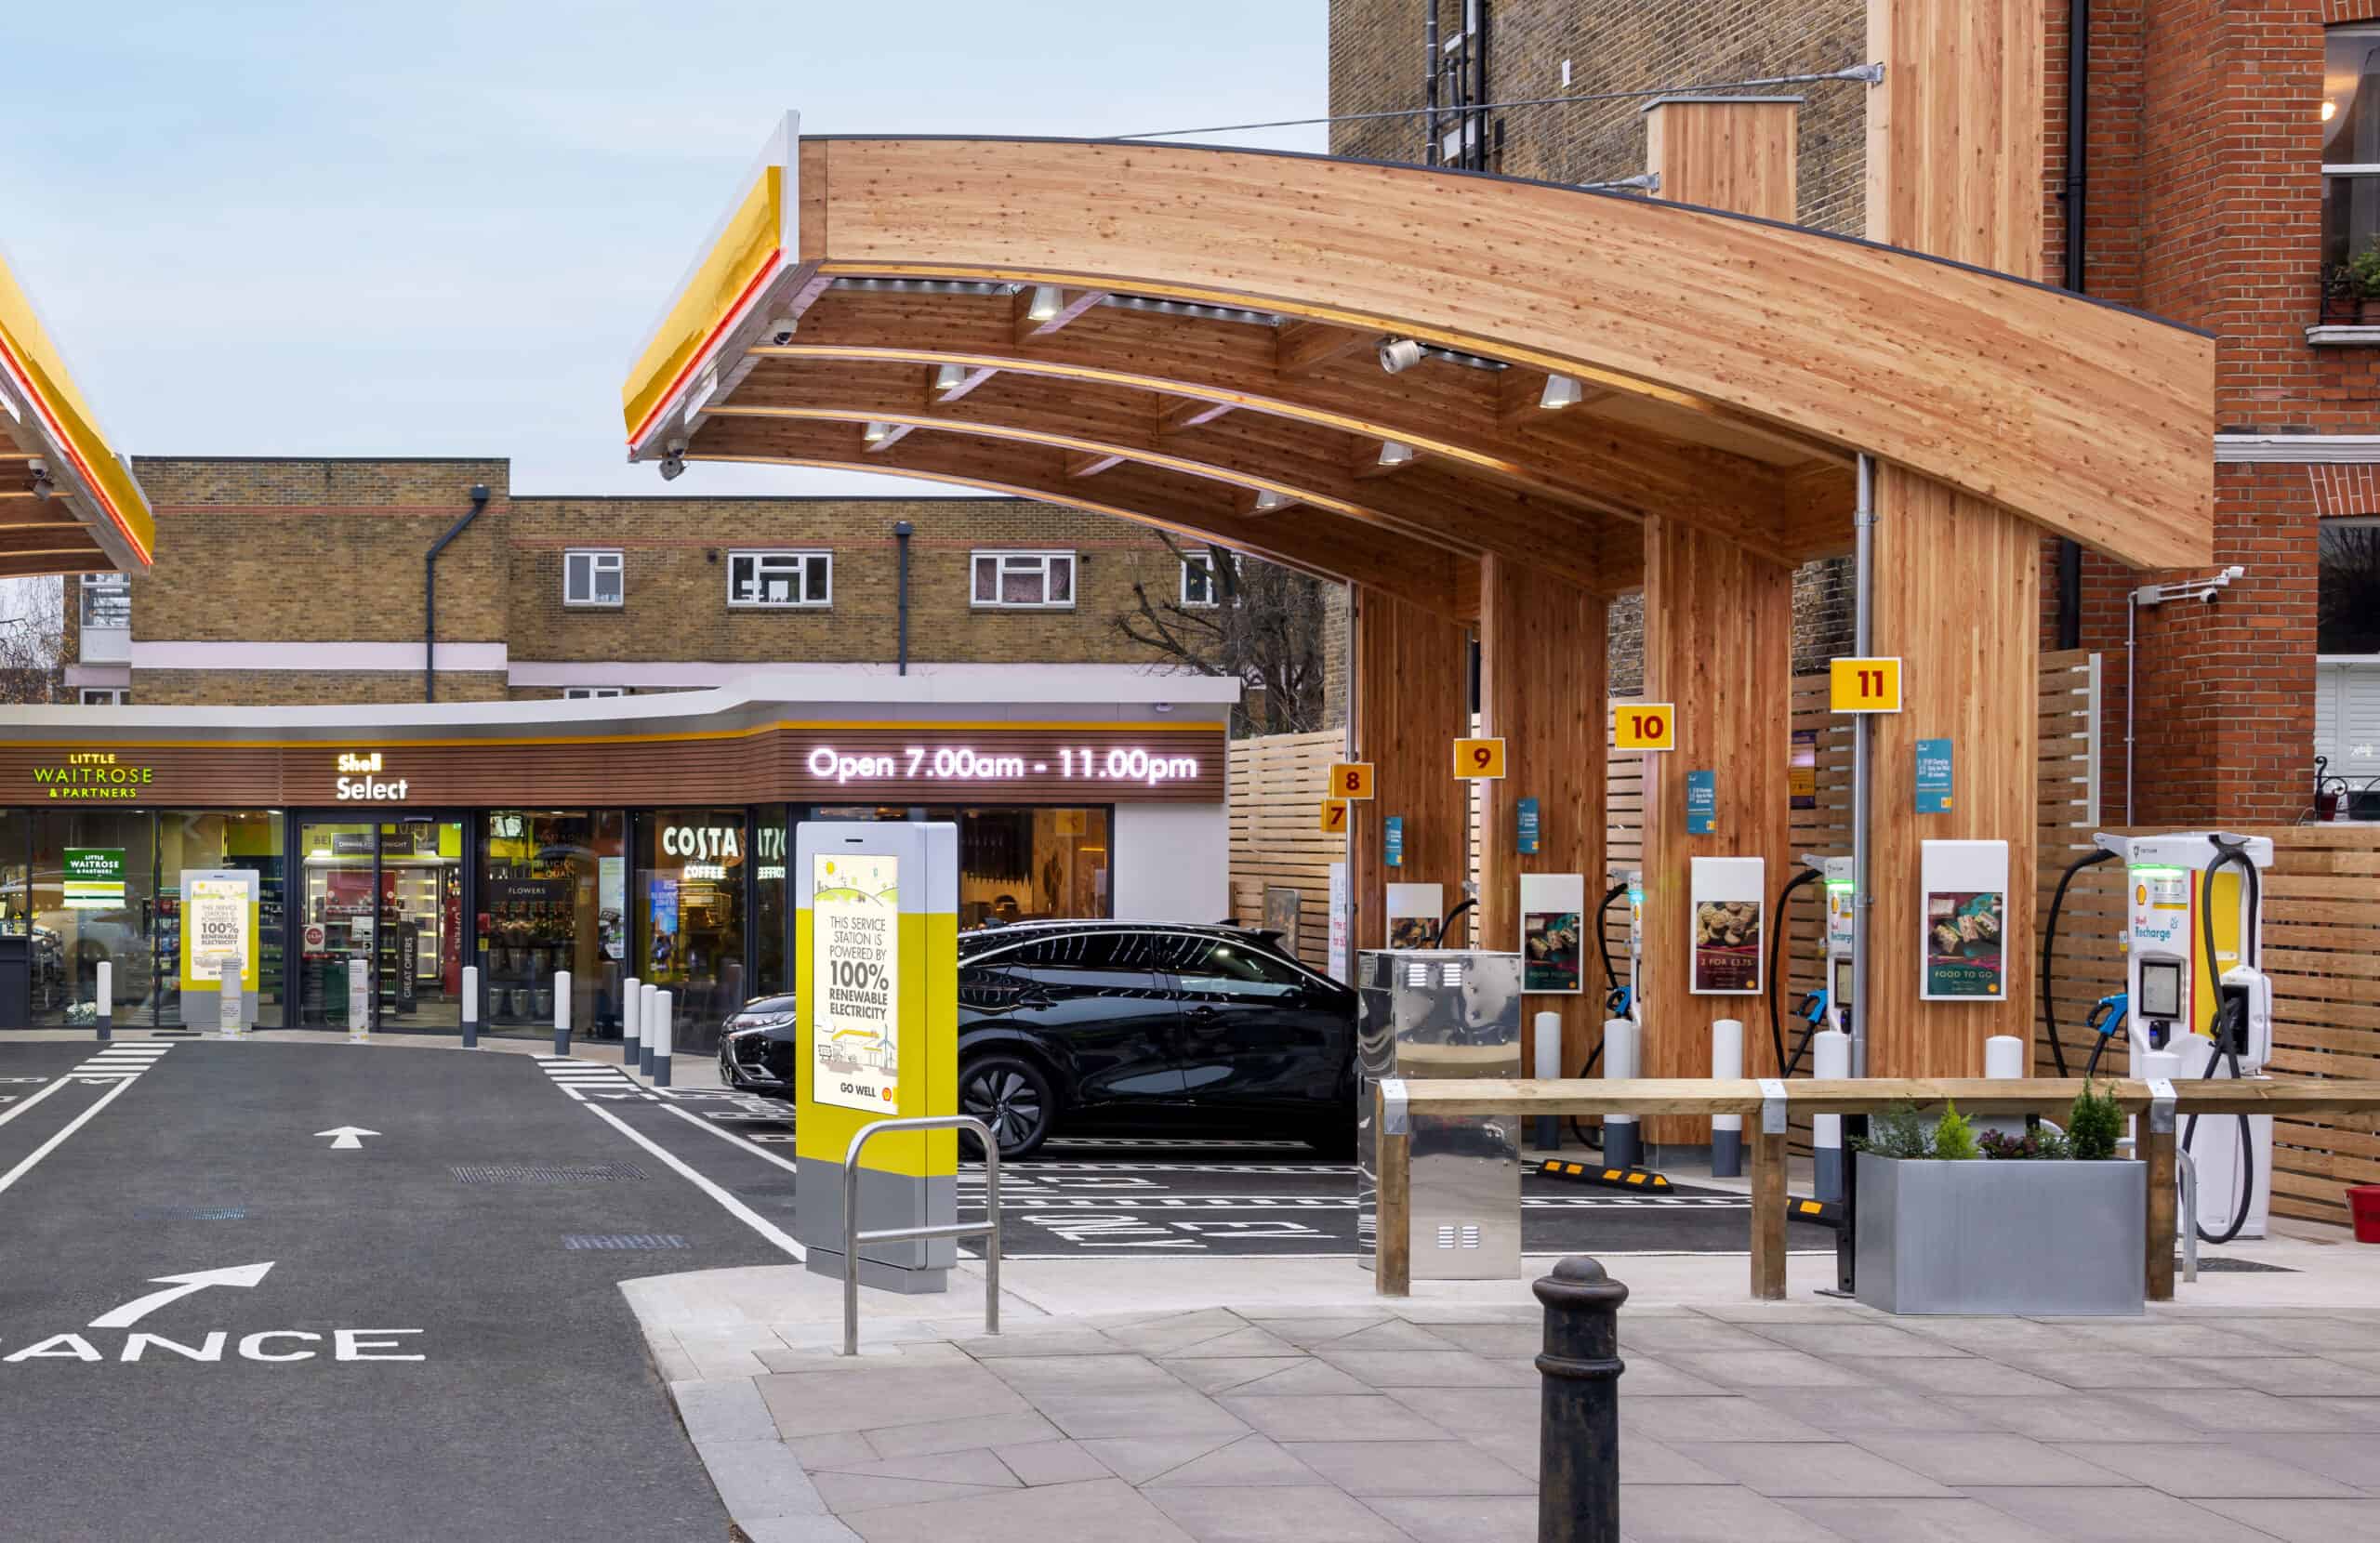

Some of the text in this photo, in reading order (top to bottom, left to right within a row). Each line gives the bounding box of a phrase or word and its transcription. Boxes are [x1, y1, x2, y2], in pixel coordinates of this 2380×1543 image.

[1858, 670, 1884, 697] 11
[1632, 715, 1664, 740] 10
[70, 754, 115, 764] LITTLE
[337, 753, 382, 772] Shell
[808, 748, 893, 783] Open
[905, 748, 1024, 779] 7.00am
[1058, 749, 1197, 785] 11.00pm
[1474, 747, 1491, 769] 9
[33, 769, 152, 783] WAITROSE
[1345, 772, 1360, 791] 8
[49, 788, 137, 798] & PARTNERS
[337, 775, 408, 799] Select
[1330, 807, 1346, 825] 7
[663, 826, 739, 861] COSTA
[684, 865, 726, 879] COFFEE
[202, 922, 239, 934] 100%
[830, 917, 886, 931] THIS SERVICE
[833, 930, 882, 946] STATION IS
[829, 945, 887, 961] POWERED BY
[403, 936, 414, 998] GREAT OFFERS
[830, 960, 890, 991] 100%
[1935, 970, 1994, 979] FOOD TO GO
[829, 988, 888, 1006] RENEWABLE
[829, 1004, 887, 1021] ELECTRICITY
[840, 1082, 877, 1098] GO WELL
[0, 1329, 426, 1363] ANCE
